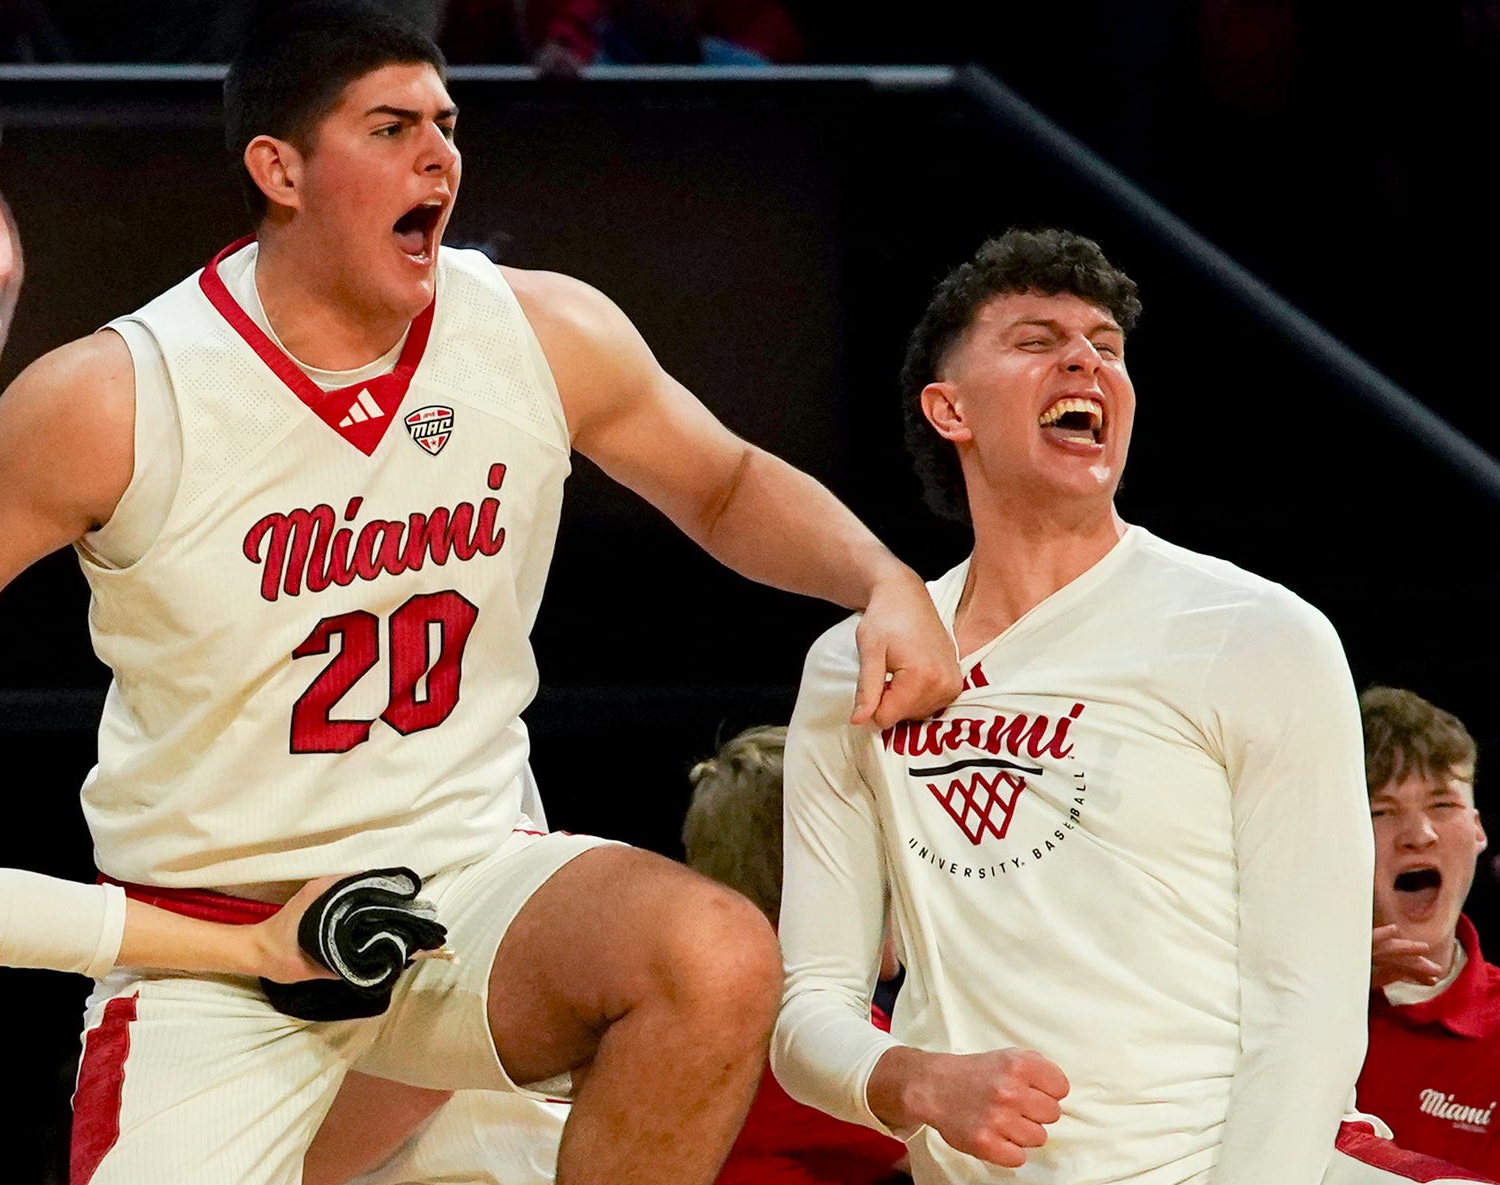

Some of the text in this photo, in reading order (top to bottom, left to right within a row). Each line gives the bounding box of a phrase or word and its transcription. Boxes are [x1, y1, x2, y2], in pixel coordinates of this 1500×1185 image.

[410, 418, 454, 440] MAC
[242, 462, 507, 602] Miami
[289, 589, 479, 755] 20
[1419, 1088, 1497, 1126] Miami
